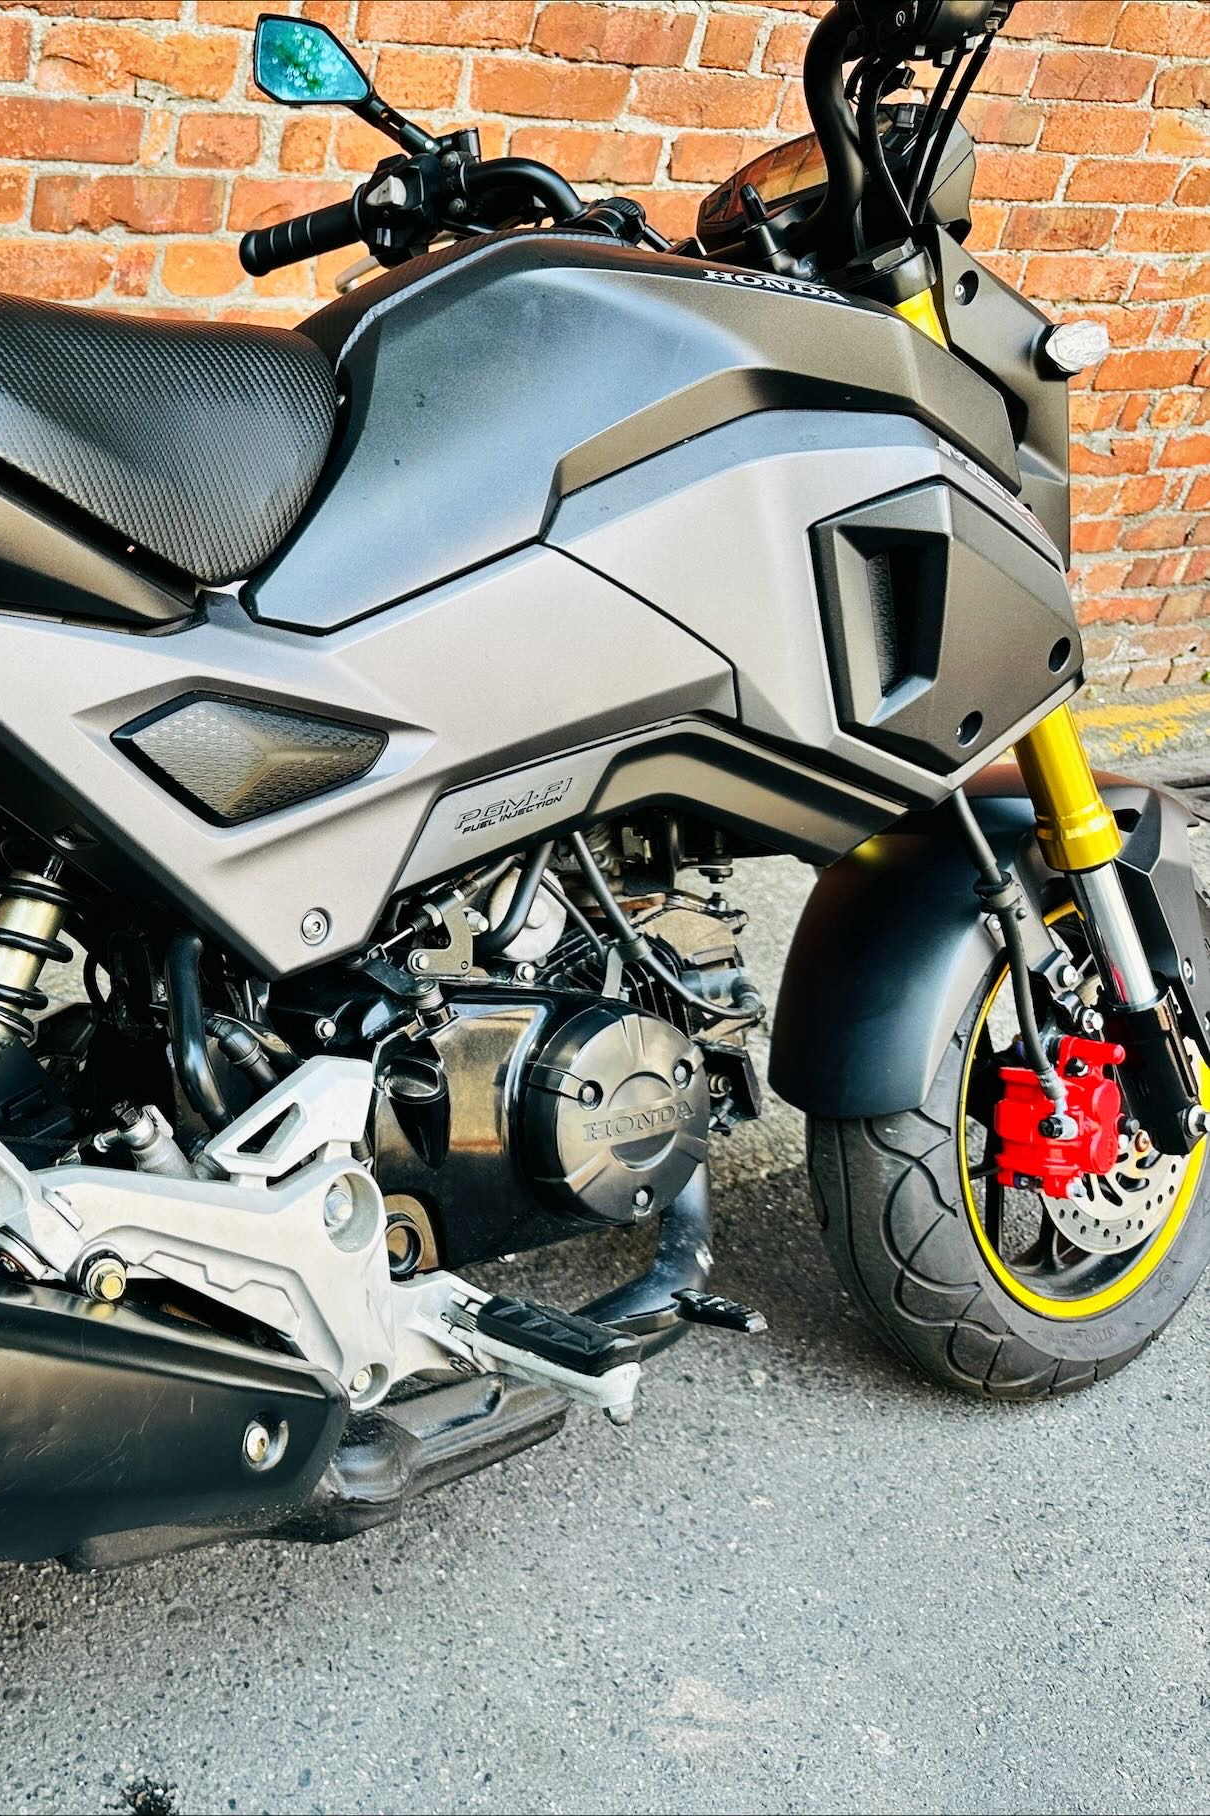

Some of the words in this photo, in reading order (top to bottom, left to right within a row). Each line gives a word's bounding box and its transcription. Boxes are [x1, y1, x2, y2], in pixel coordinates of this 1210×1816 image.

[702, 269, 851, 303] HONDA
[462, 818, 496, 835] FUEL
[498, 794, 564, 823] INJECTION
[582, 1100, 696, 1142] HONDA
